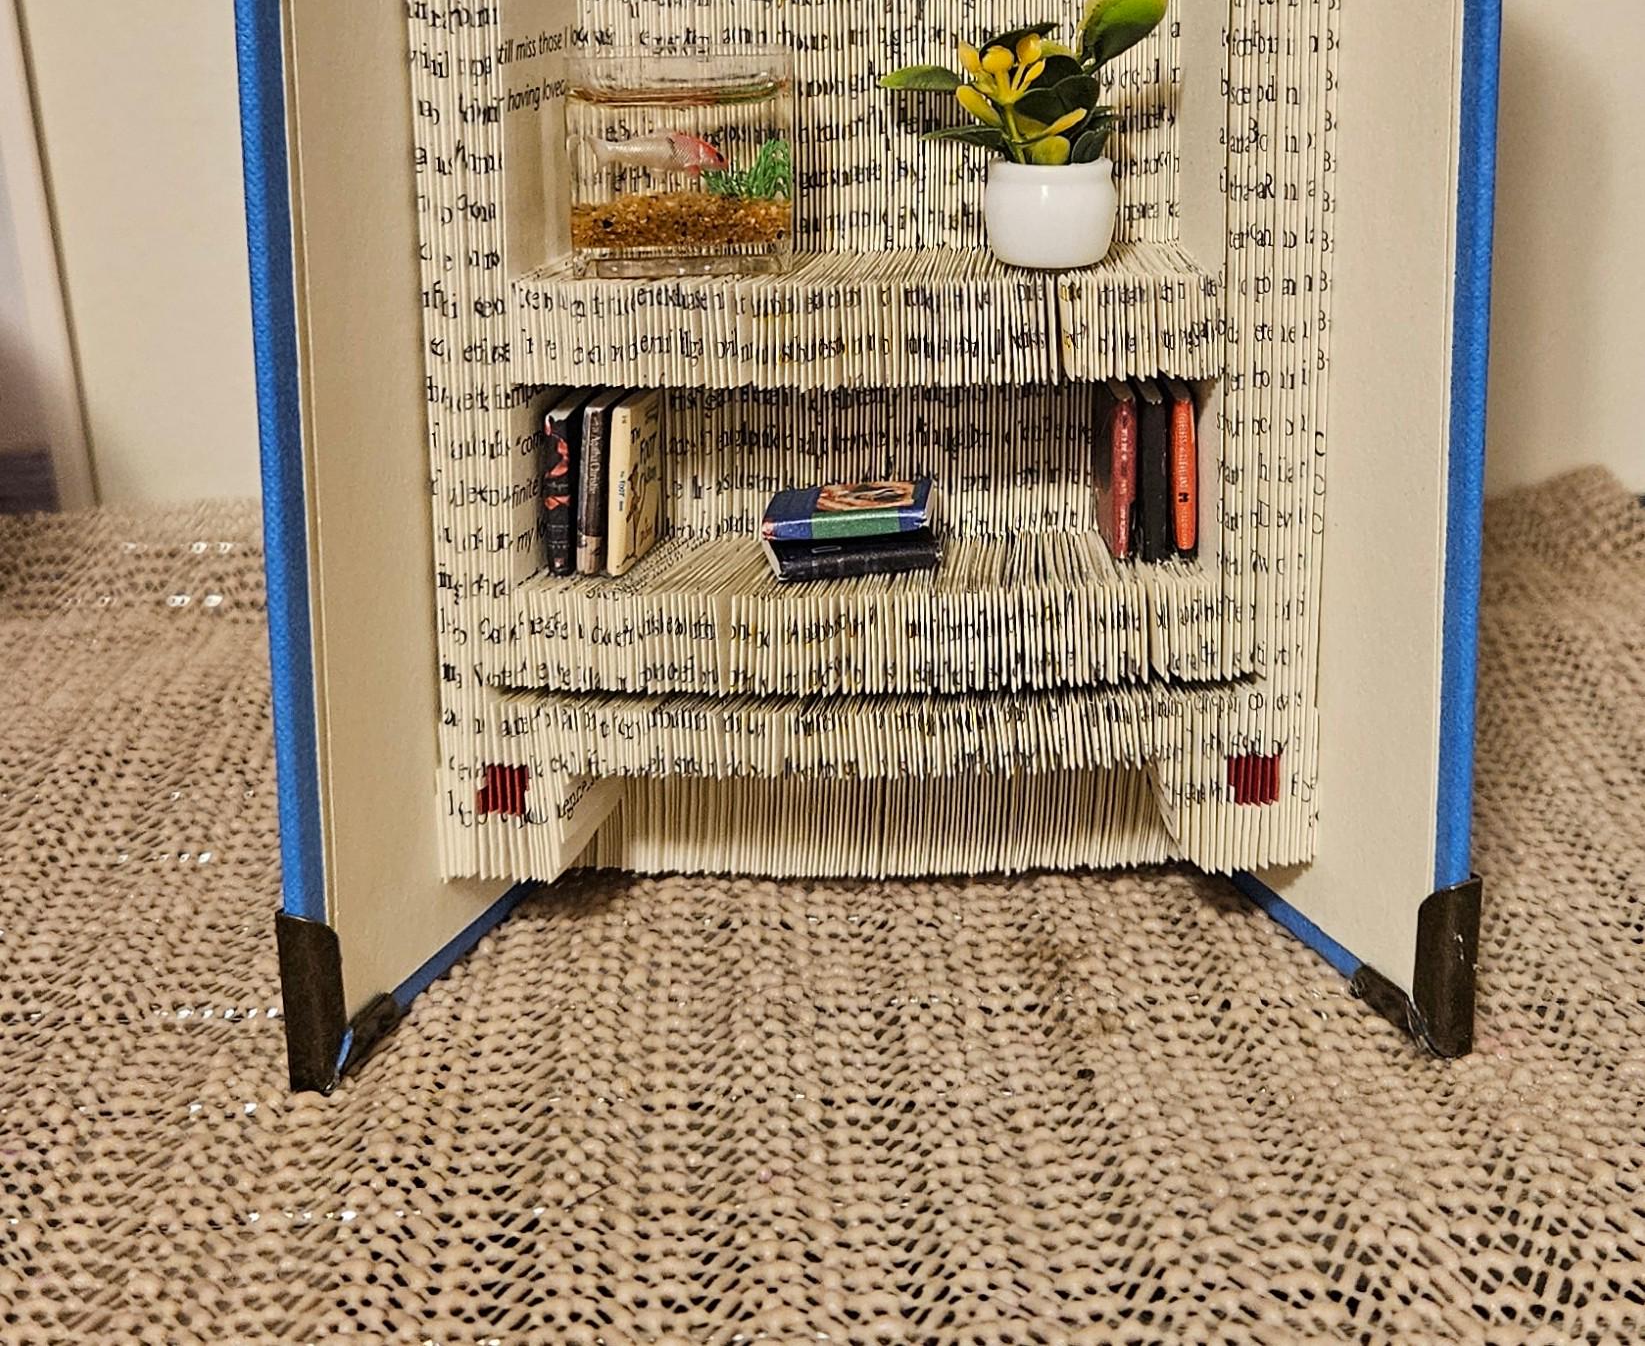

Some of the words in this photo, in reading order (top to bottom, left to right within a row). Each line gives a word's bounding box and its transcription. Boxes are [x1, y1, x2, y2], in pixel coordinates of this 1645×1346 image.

[516, 35, 537, 62] miss
[539, 30, 562, 55] those
[507, 87, 541, 112] having
[589, 434, 602, 462] Agatha
[588, 462, 601, 495] Christie
[516, 527, 534, 553] my
